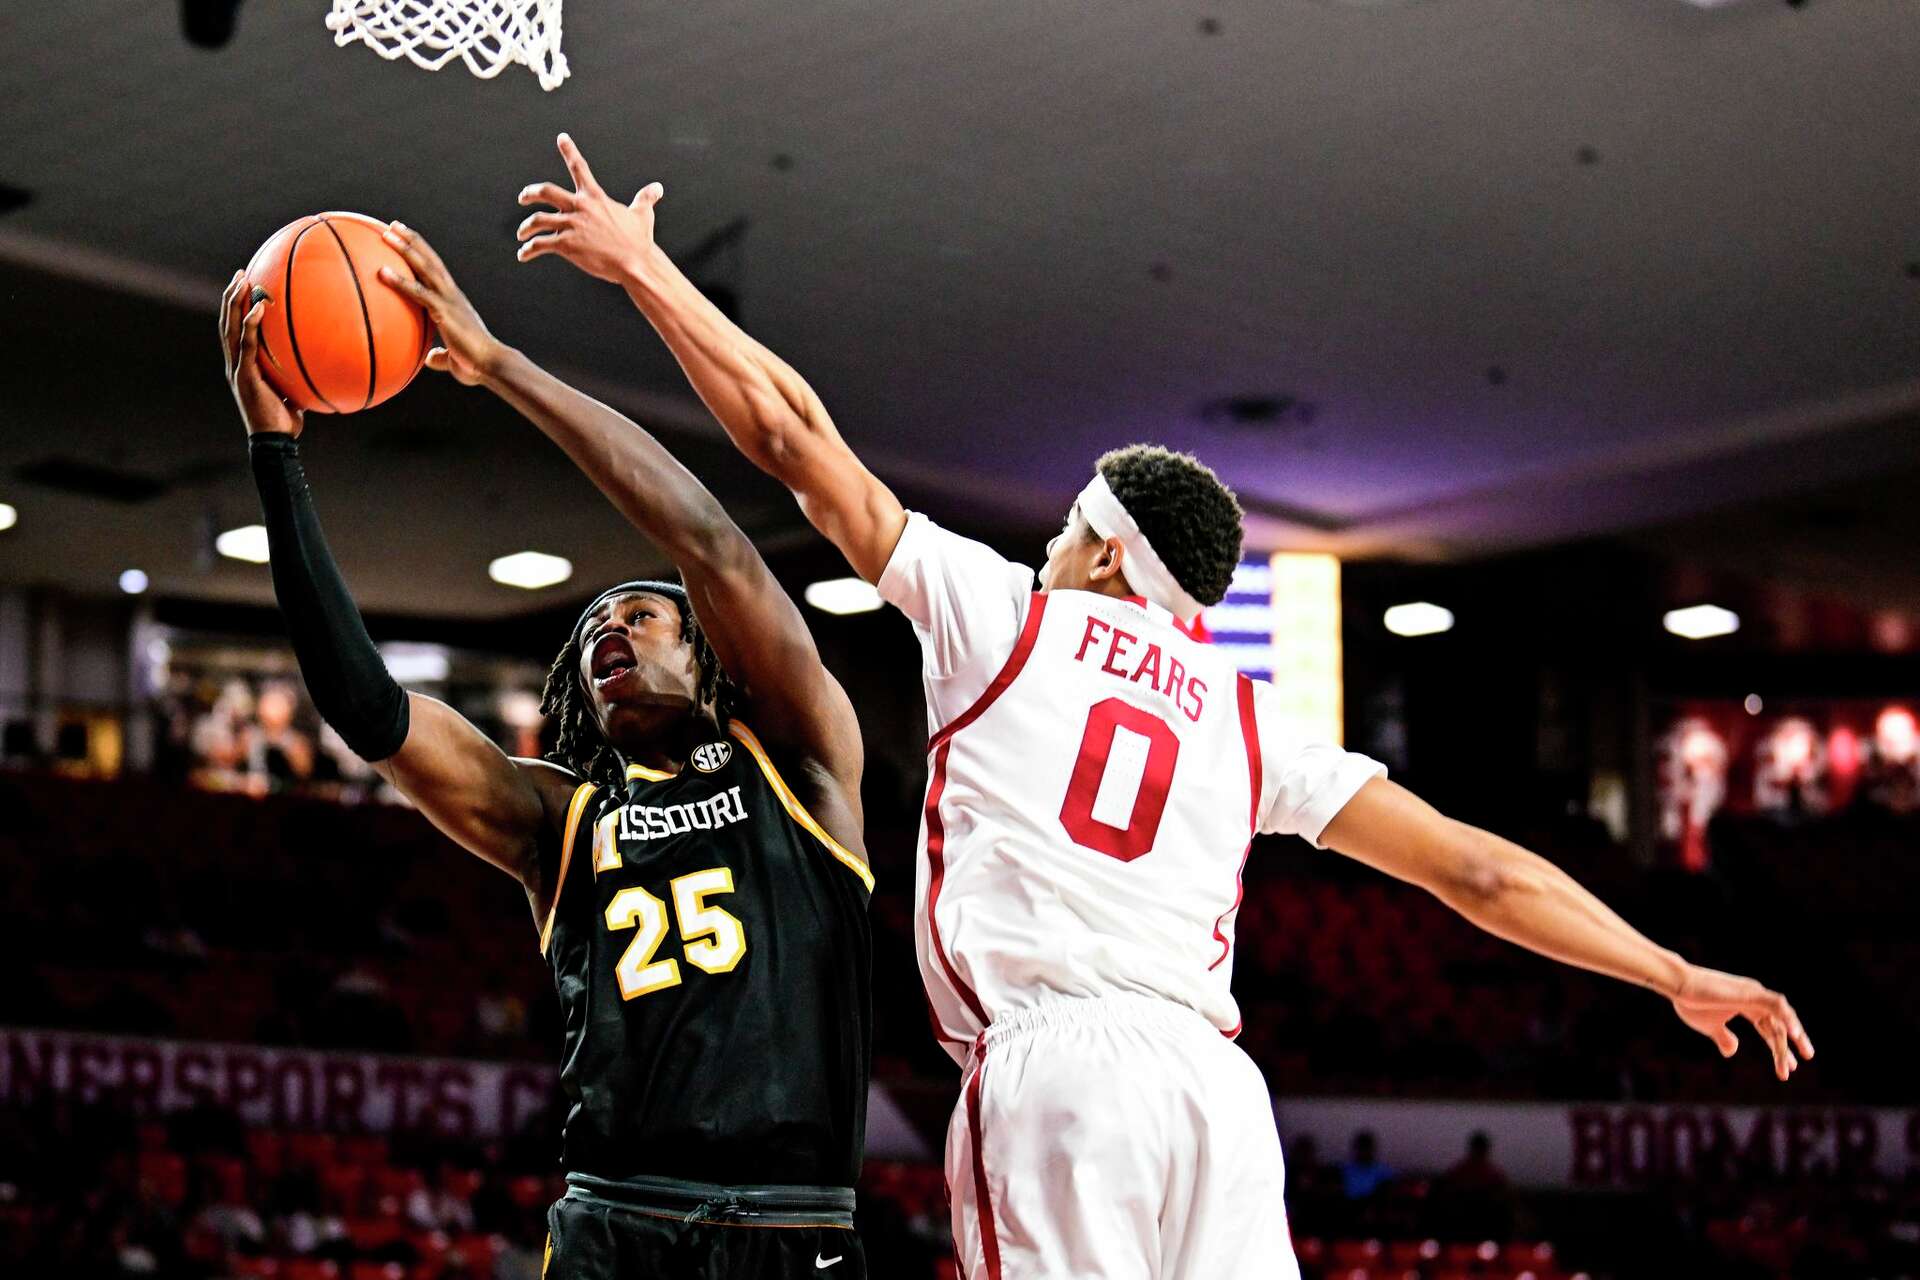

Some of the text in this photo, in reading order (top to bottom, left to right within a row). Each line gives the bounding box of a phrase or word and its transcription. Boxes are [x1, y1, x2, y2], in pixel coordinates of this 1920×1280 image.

[1074, 615, 1208, 722] FEARS
[694, 742, 729, 770] SEC
[1059, 697, 1180, 862] 0
[605, 867, 747, 1001] 25
[1573, 1107, 1875, 1186] BOOMER
